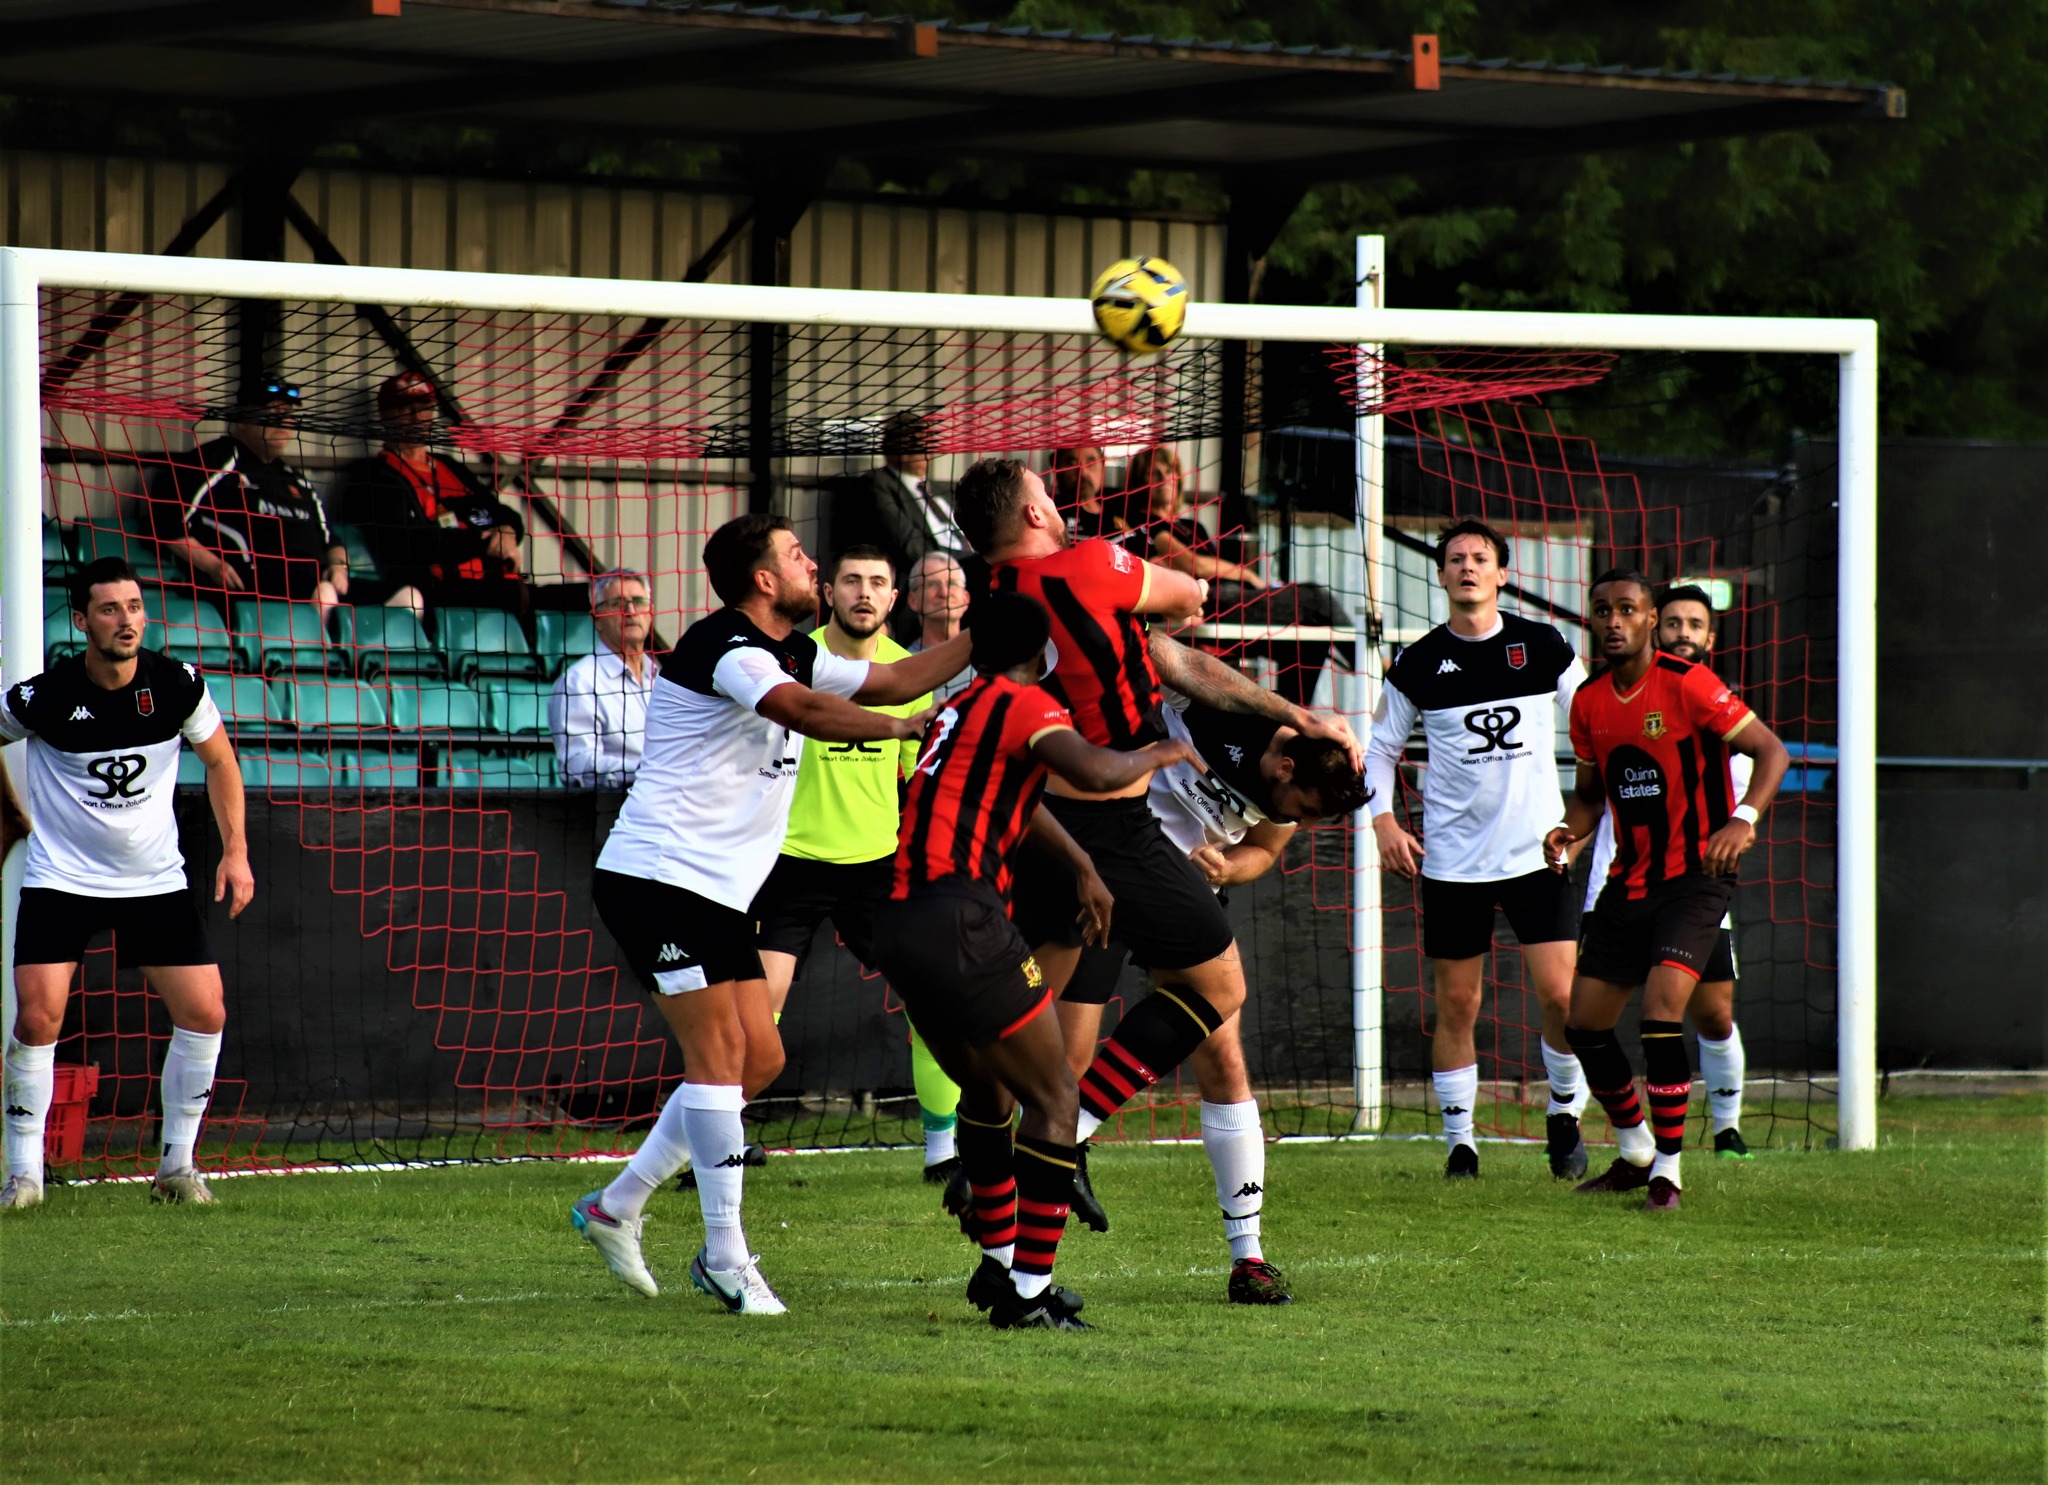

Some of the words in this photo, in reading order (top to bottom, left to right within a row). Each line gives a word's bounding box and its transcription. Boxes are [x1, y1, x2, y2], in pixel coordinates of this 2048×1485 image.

[1482, 755, 1503, 763] Office
[1625, 766, 1658, 782] Quinn
[1179, 778, 1197, 800] Smart
[1196, 797, 1214, 815] Office
[1619, 783, 1662, 799] Estates
[100, 801, 123, 810] Office
